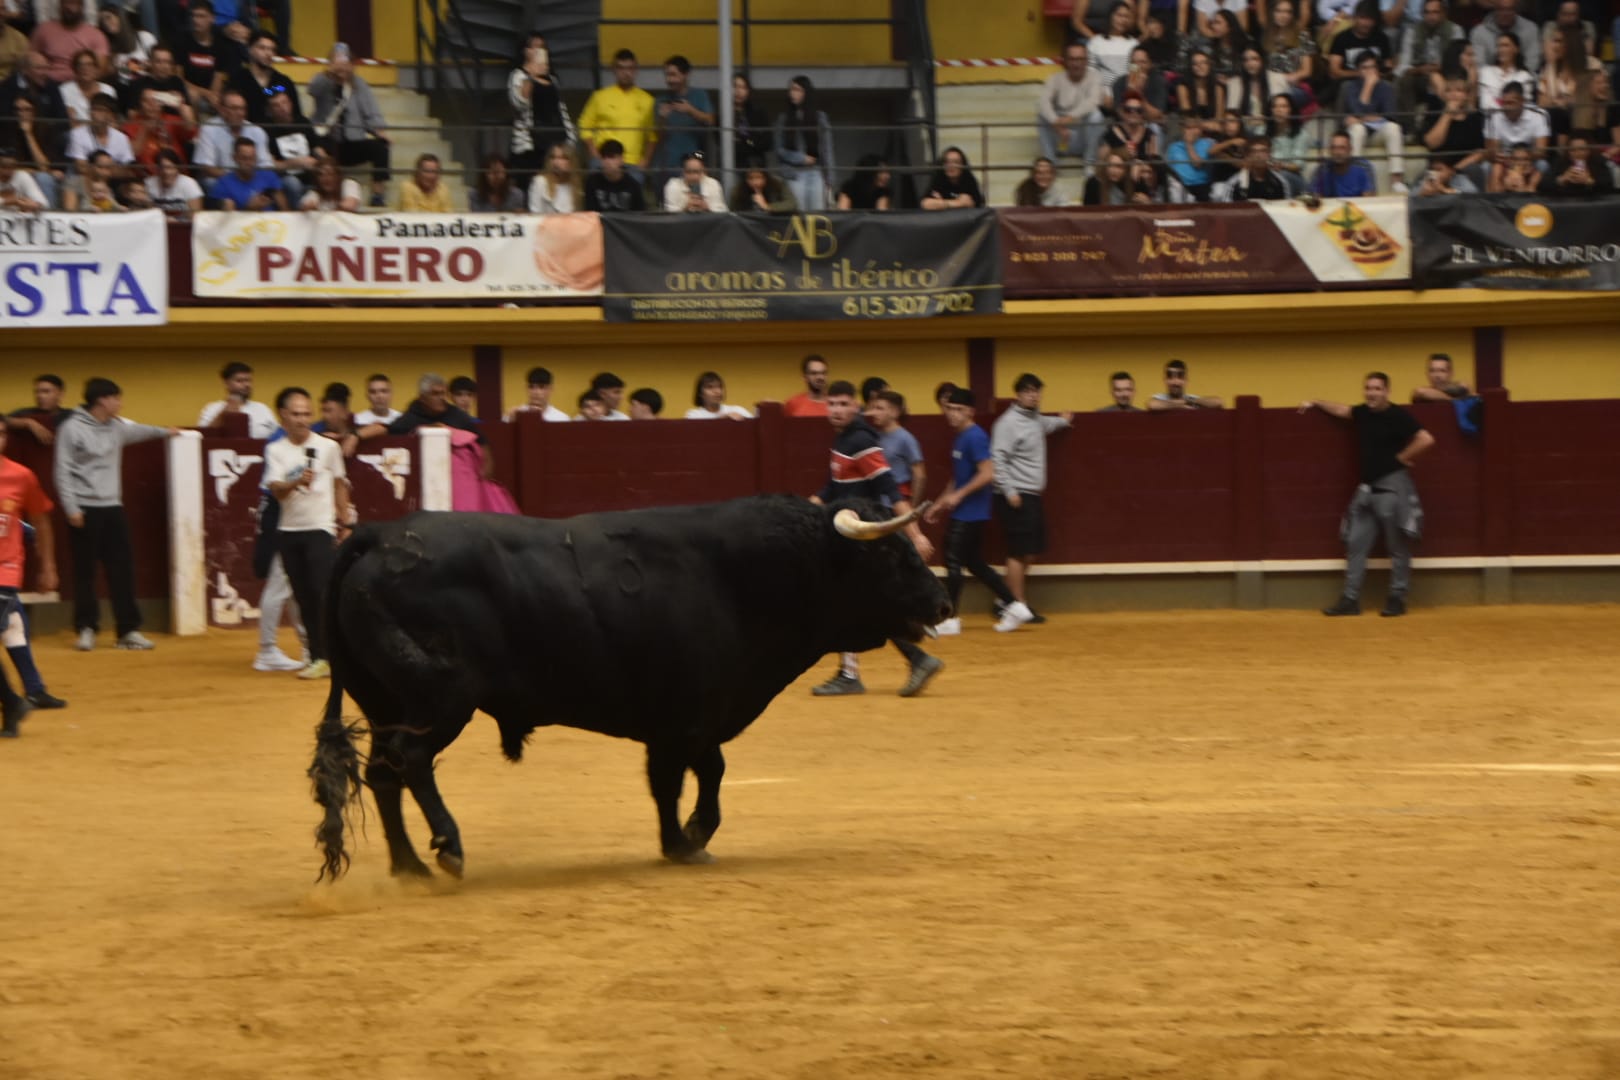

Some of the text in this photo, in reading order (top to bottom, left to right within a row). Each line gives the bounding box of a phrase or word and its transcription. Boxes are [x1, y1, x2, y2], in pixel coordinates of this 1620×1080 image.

[257, 234, 484, 283] PAÑERO
[1451, 244, 1479, 264] EL
[665, 257, 939, 292] aromas de ibérico
[842, 296, 885, 317] 615
[887, 295, 930, 315] 307
